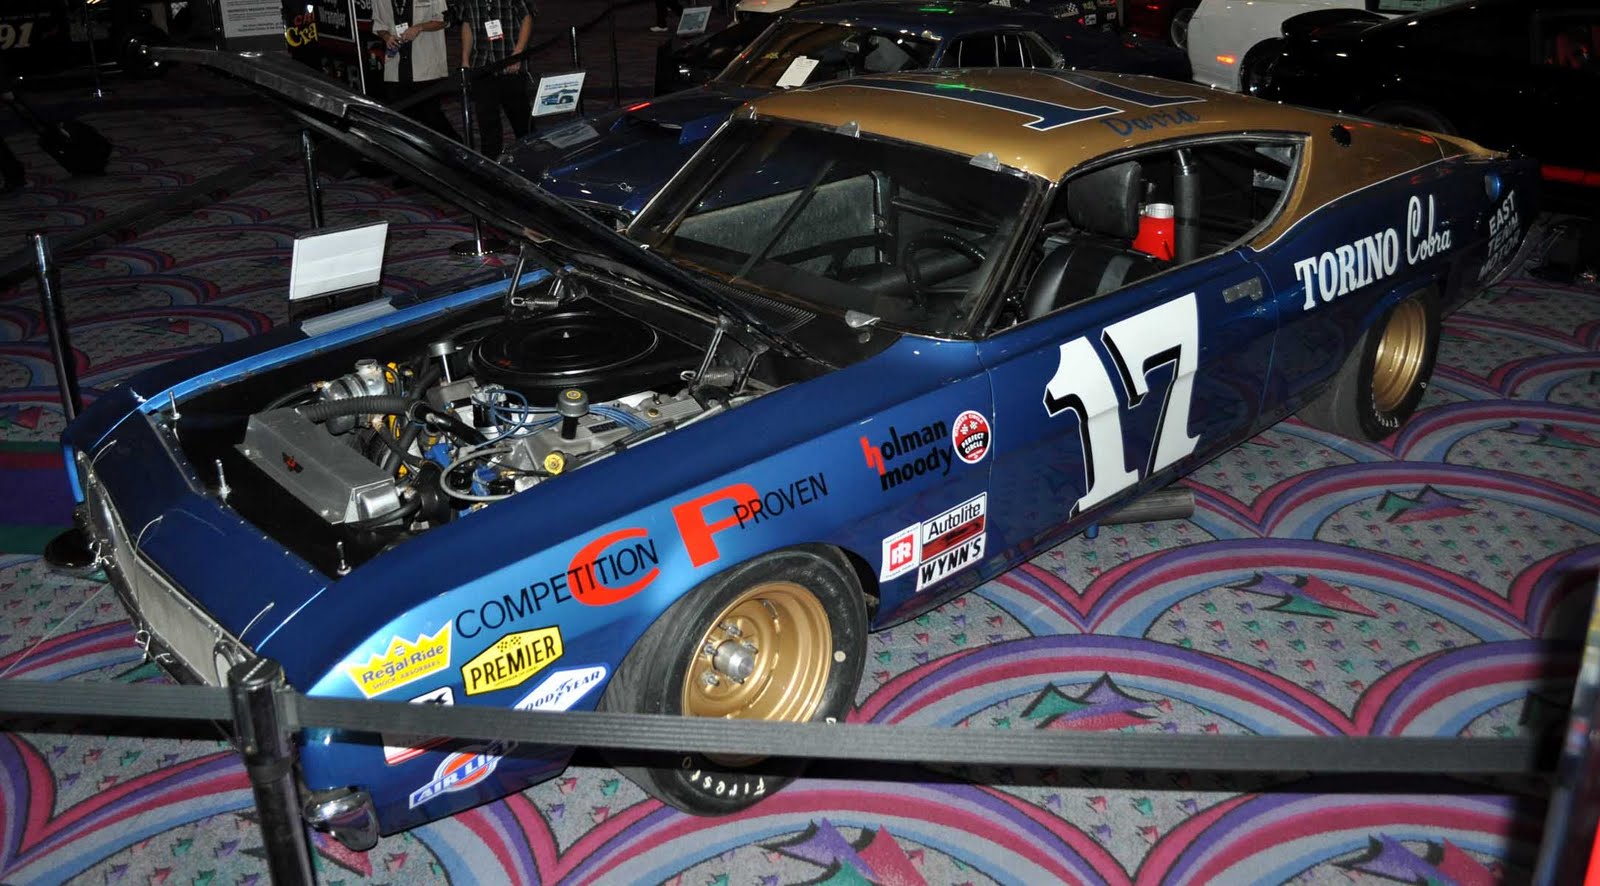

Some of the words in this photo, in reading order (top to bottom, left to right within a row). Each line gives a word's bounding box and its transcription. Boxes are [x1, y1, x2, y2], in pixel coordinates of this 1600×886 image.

[1489, 189, 1516, 239] EAST
[1294, 228, 1399, 310] TORINO
[1406, 194, 1452, 265] Cobra
[1043, 292, 1200, 521] 17
[859, 420, 948, 476] holman
[961, 432, 984, 449] PERFECT
[964, 440, 984, 454] CIRCLE
[880, 446, 953, 491] moody
[732, 472, 829, 530] PROVEN
[928, 502, 981, 540] Autolite
[921, 537, 982, 584] WYNN'S
[455, 538, 659, 639] COMPETITION
[362, 658, 408, 683] Regal
[410, 645, 445, 665] Ride
[470, 635, 556, 690] PREMIER
[524, 670, 601, 711] OODYEAR
[418, 773, 459, 803] AIR
[681, 755, 767, 797] Firesto
